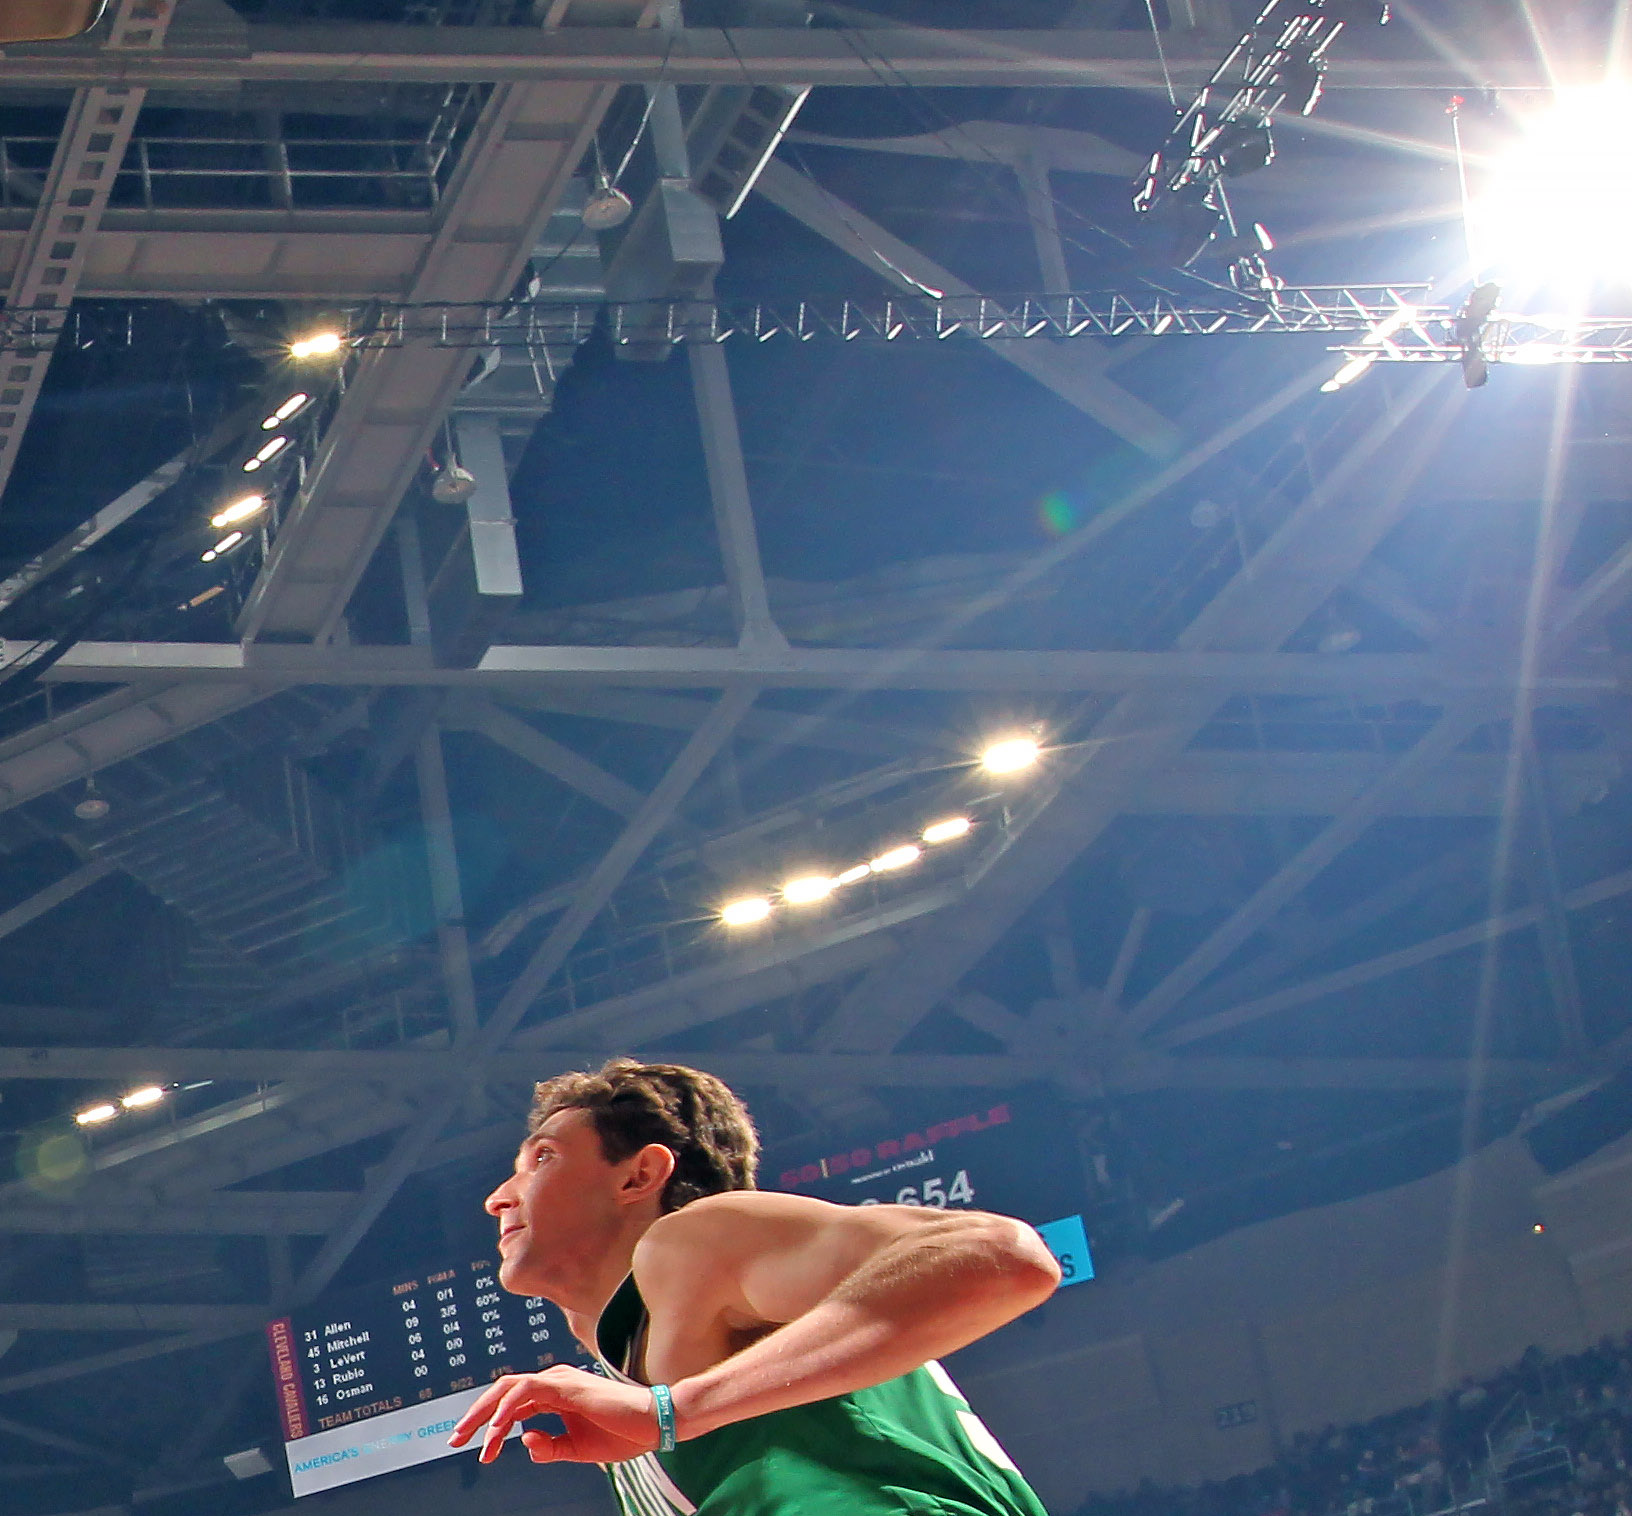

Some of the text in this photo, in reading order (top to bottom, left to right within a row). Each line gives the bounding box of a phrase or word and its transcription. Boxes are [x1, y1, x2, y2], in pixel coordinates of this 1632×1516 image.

[304, 1275, 494, 1343] 31 Allen 04 0/1 0%
[307, 1346, 321, 1359] 45
[327, 1331, 370, 1354] Mitchell
[405, 1316, 420, 1330] 09
[439, 1304, 458, 1319] 3/5
[475, 1292, 501, 1308] 60%
[313, 1308, 547, 1374] 3 LeVert 06 0/4 0% 0/0
[271, 1322, 305, 1440] CLEVELAND CAVALIERS
[314, 1325, 550, 1391] 13 Rubio 04 0/0 0% 0/0
[316, 1341, 507, 1406] 16 Osman 00 0/0 0%
[317, 1410, 353, 1430] TEAM
[355, 1395, 404, 1418] TOTALS
[294, 1446, 359, 1474] AMERICA'S
